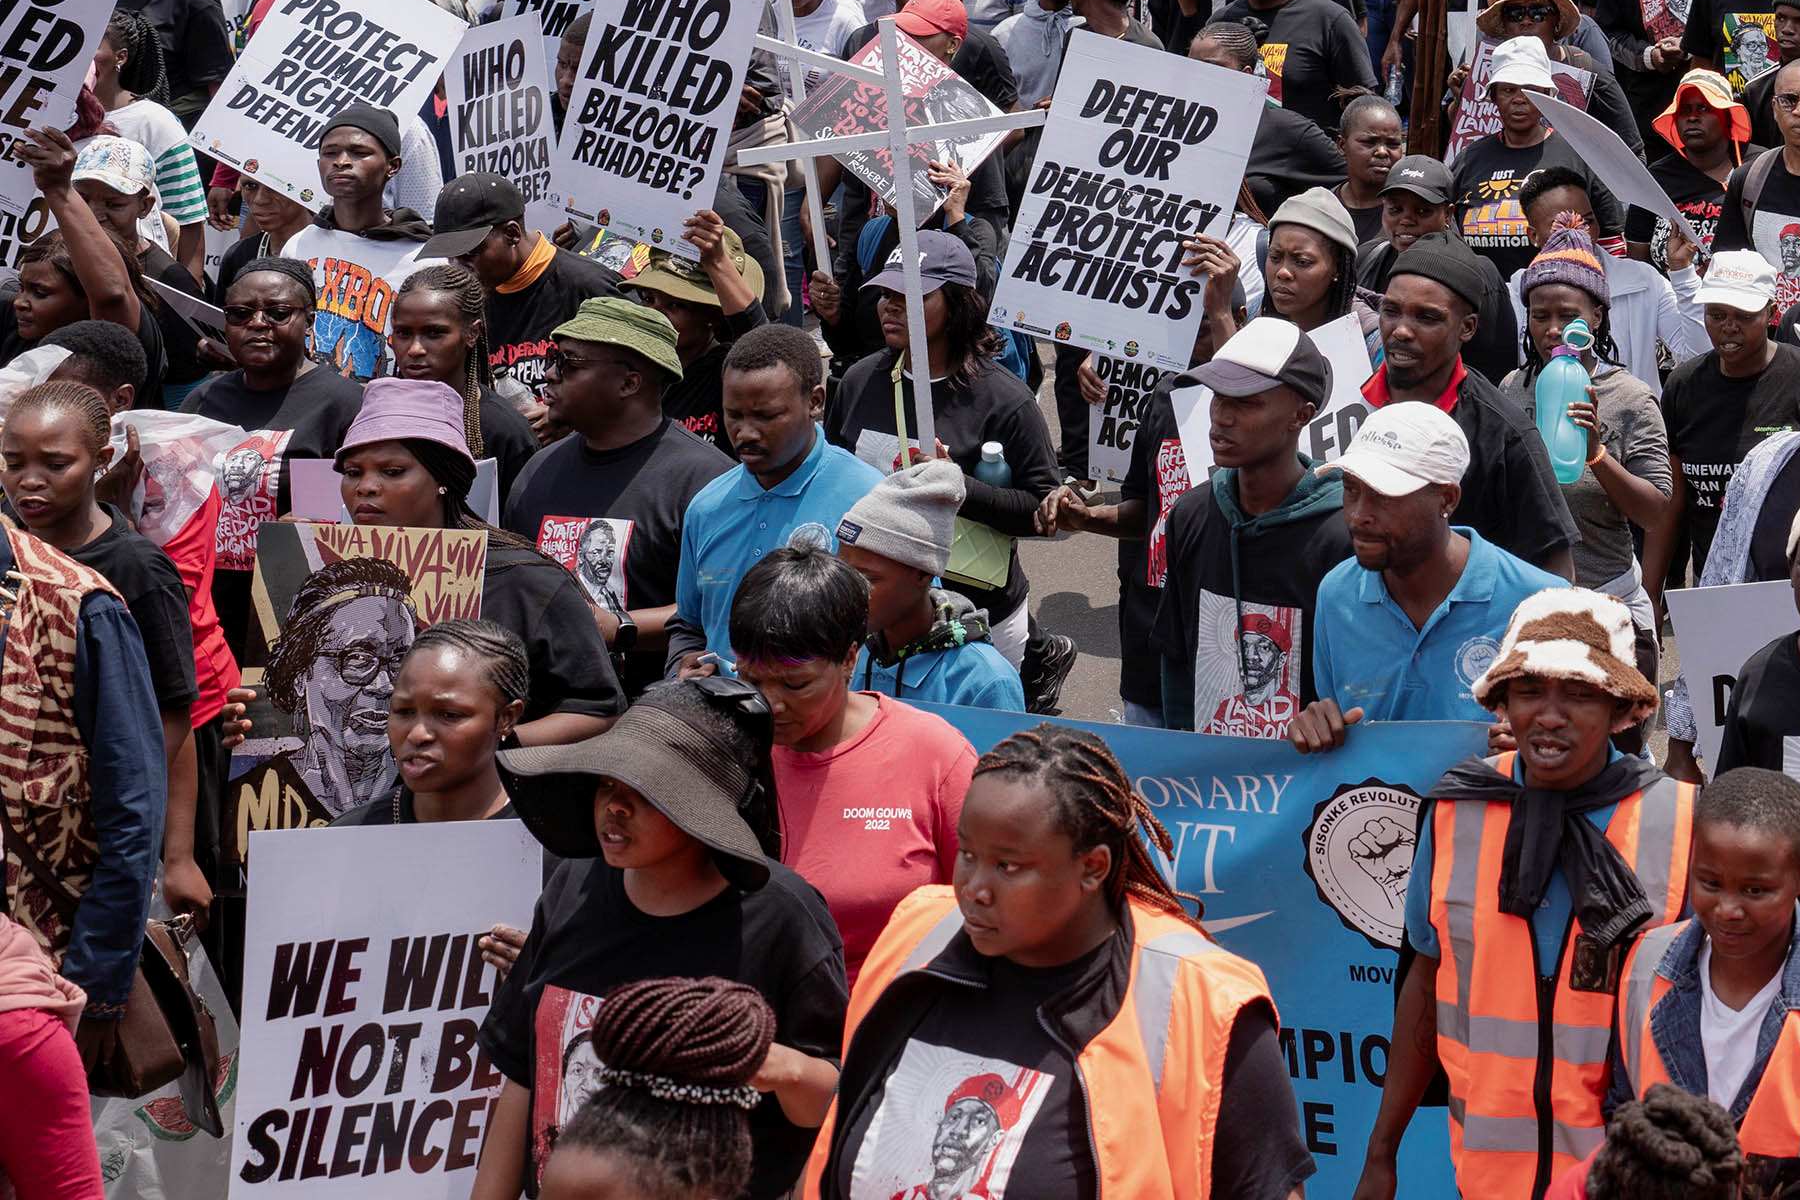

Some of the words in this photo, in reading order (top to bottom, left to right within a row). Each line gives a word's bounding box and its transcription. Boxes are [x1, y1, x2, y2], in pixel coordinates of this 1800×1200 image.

[262, 58, 372, 120] RIGH
[282, 28, 409, 108] HUMAN
[463, 39, 526, 99] WHO
[584, 23, 734, 116] KILLED
[457, 86, 543, 153] KILLED
[577, 87, 719, 165] BAZOOKA
[1079, 78, 1219, 146] DEFEND
[571, 130, 705, 201] RHADEBE?
[847, 160, 891, 191] RADEBE
[1098, 128, 1181, 181] OUR
[1491, 169, 1516, 181] JUST
[1030, 161, 1222, 235] DEMOCRACY
[1031, 199, 1200, 274] PROTECT
[1463, 235, 1530, 248] TRANSITION
[1011, 241, 1201, 320] ACTIVISTS
[221, 495, 273, 520] AND
[318, 525, 368, 553] VIVA
[371, 527, 453, 604] VIVA
[1225, 695, 1294, 726] LAND
[842, 807, 876, 820] DOOM
[877, 807, 913, 819] GOUWS
[864, 819, 891, 831] 2022
[1315, 800, 1349, 856] SISONKE
[265, 938, 367, 1022] WE
[381, 930, 500, 1015] WIL
[1348, 964, 1399, 986] MOV
[290, 1021, 422, 1101] NOT
[430, 1016, 501, 1093] BE
